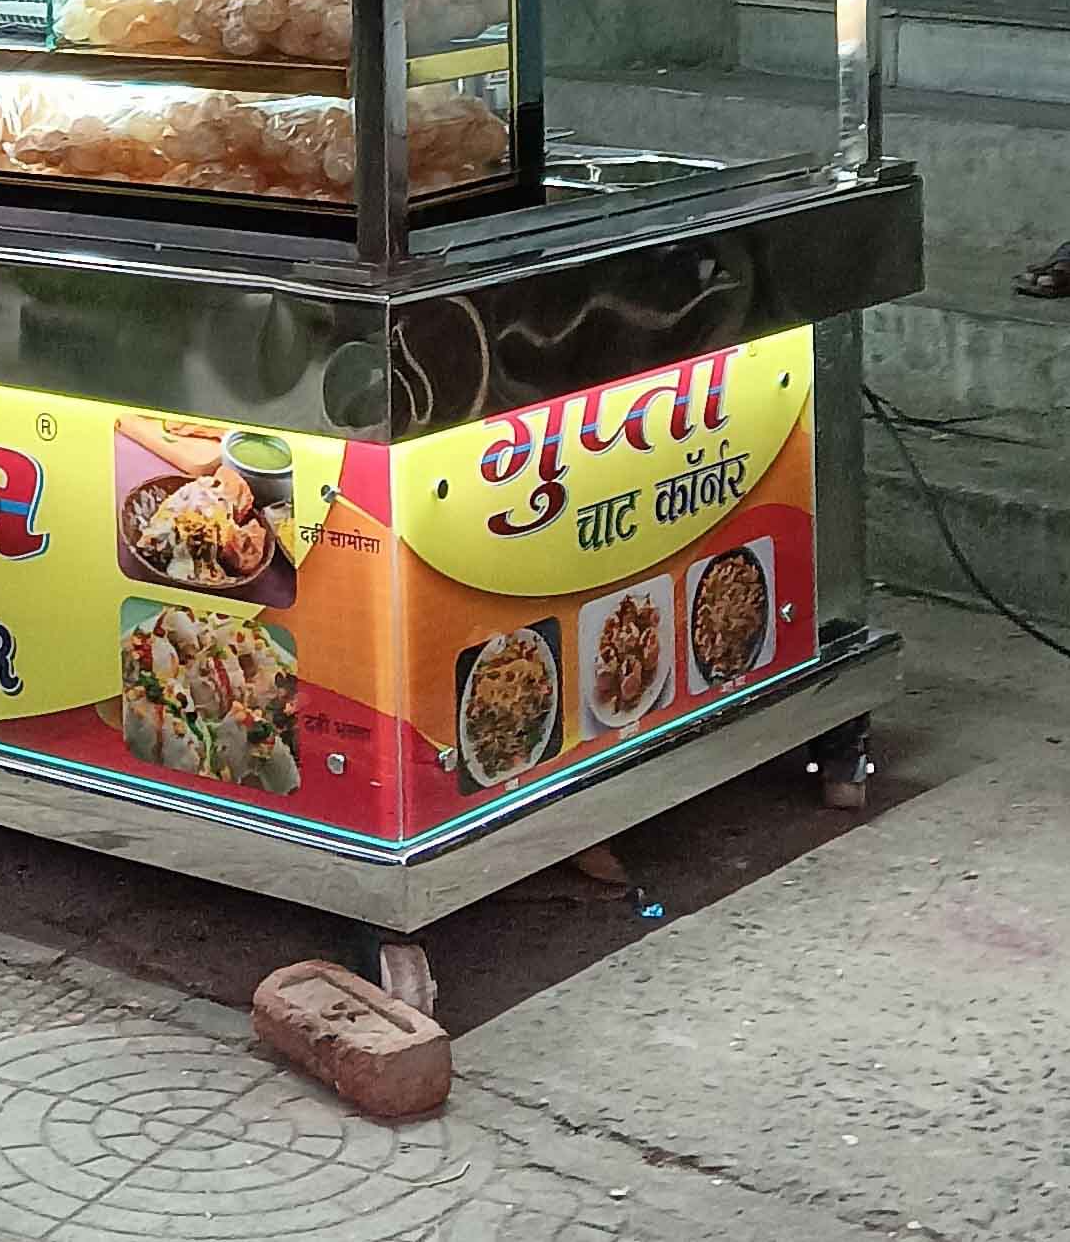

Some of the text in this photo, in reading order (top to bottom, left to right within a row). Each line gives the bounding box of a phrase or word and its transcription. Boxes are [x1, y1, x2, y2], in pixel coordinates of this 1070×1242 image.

[481, 348, 740, 538] गुप्ता
[577, 439, 750, 551] चाट कॉर्नर
[299, 522, 325, 545] दही
